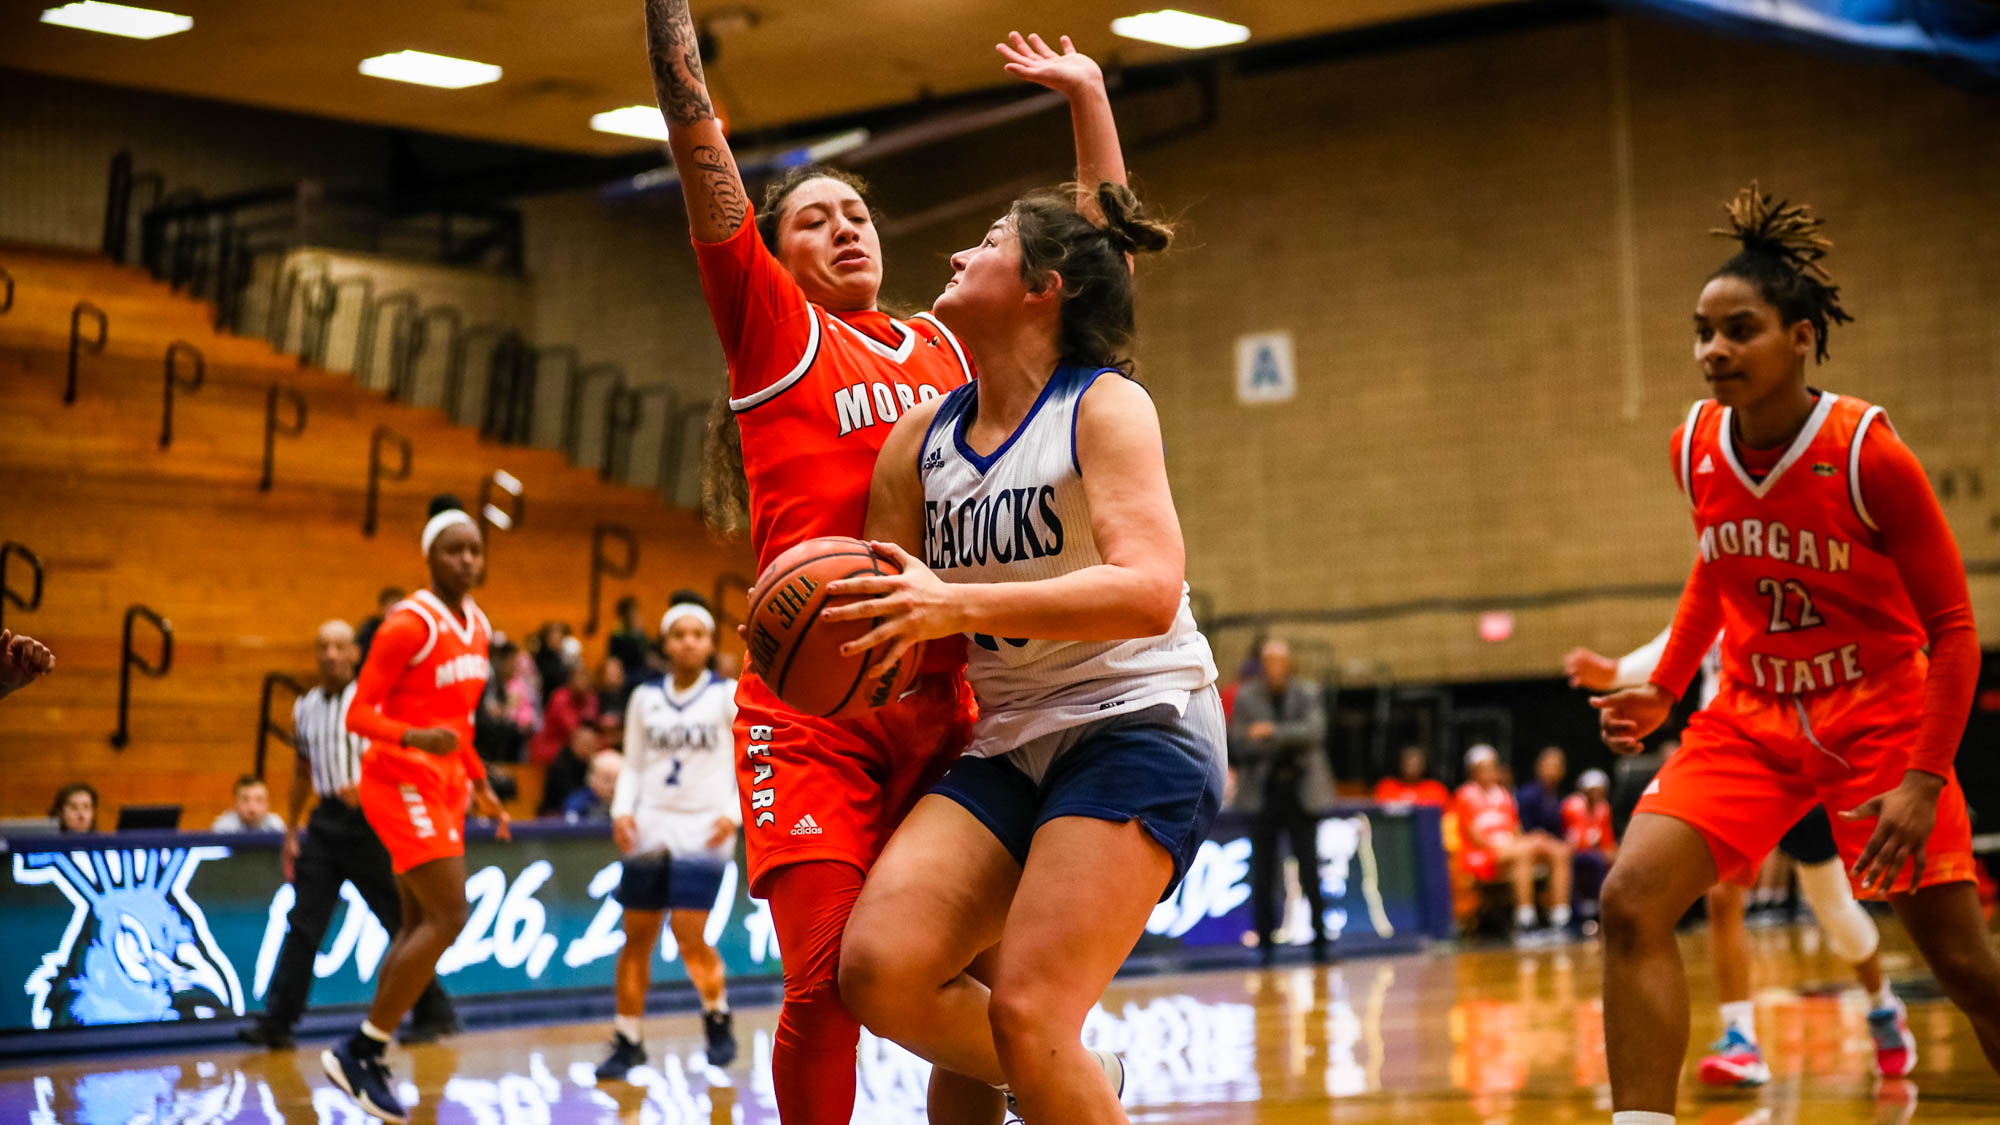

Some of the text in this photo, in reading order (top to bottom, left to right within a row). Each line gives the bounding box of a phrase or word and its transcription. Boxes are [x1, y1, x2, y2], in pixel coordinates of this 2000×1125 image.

[1250, 347, 1283, 388] A
[925, 485, 1063, 569] EACOCKS
[1700, 518, 1850, 573] MORGAN
[767, 575, 819, 630] THE
[1758, 577, 1825, 633] 22
[746, 724, 775, 829] BEARS
[790, 827, 823, 836] adidas
